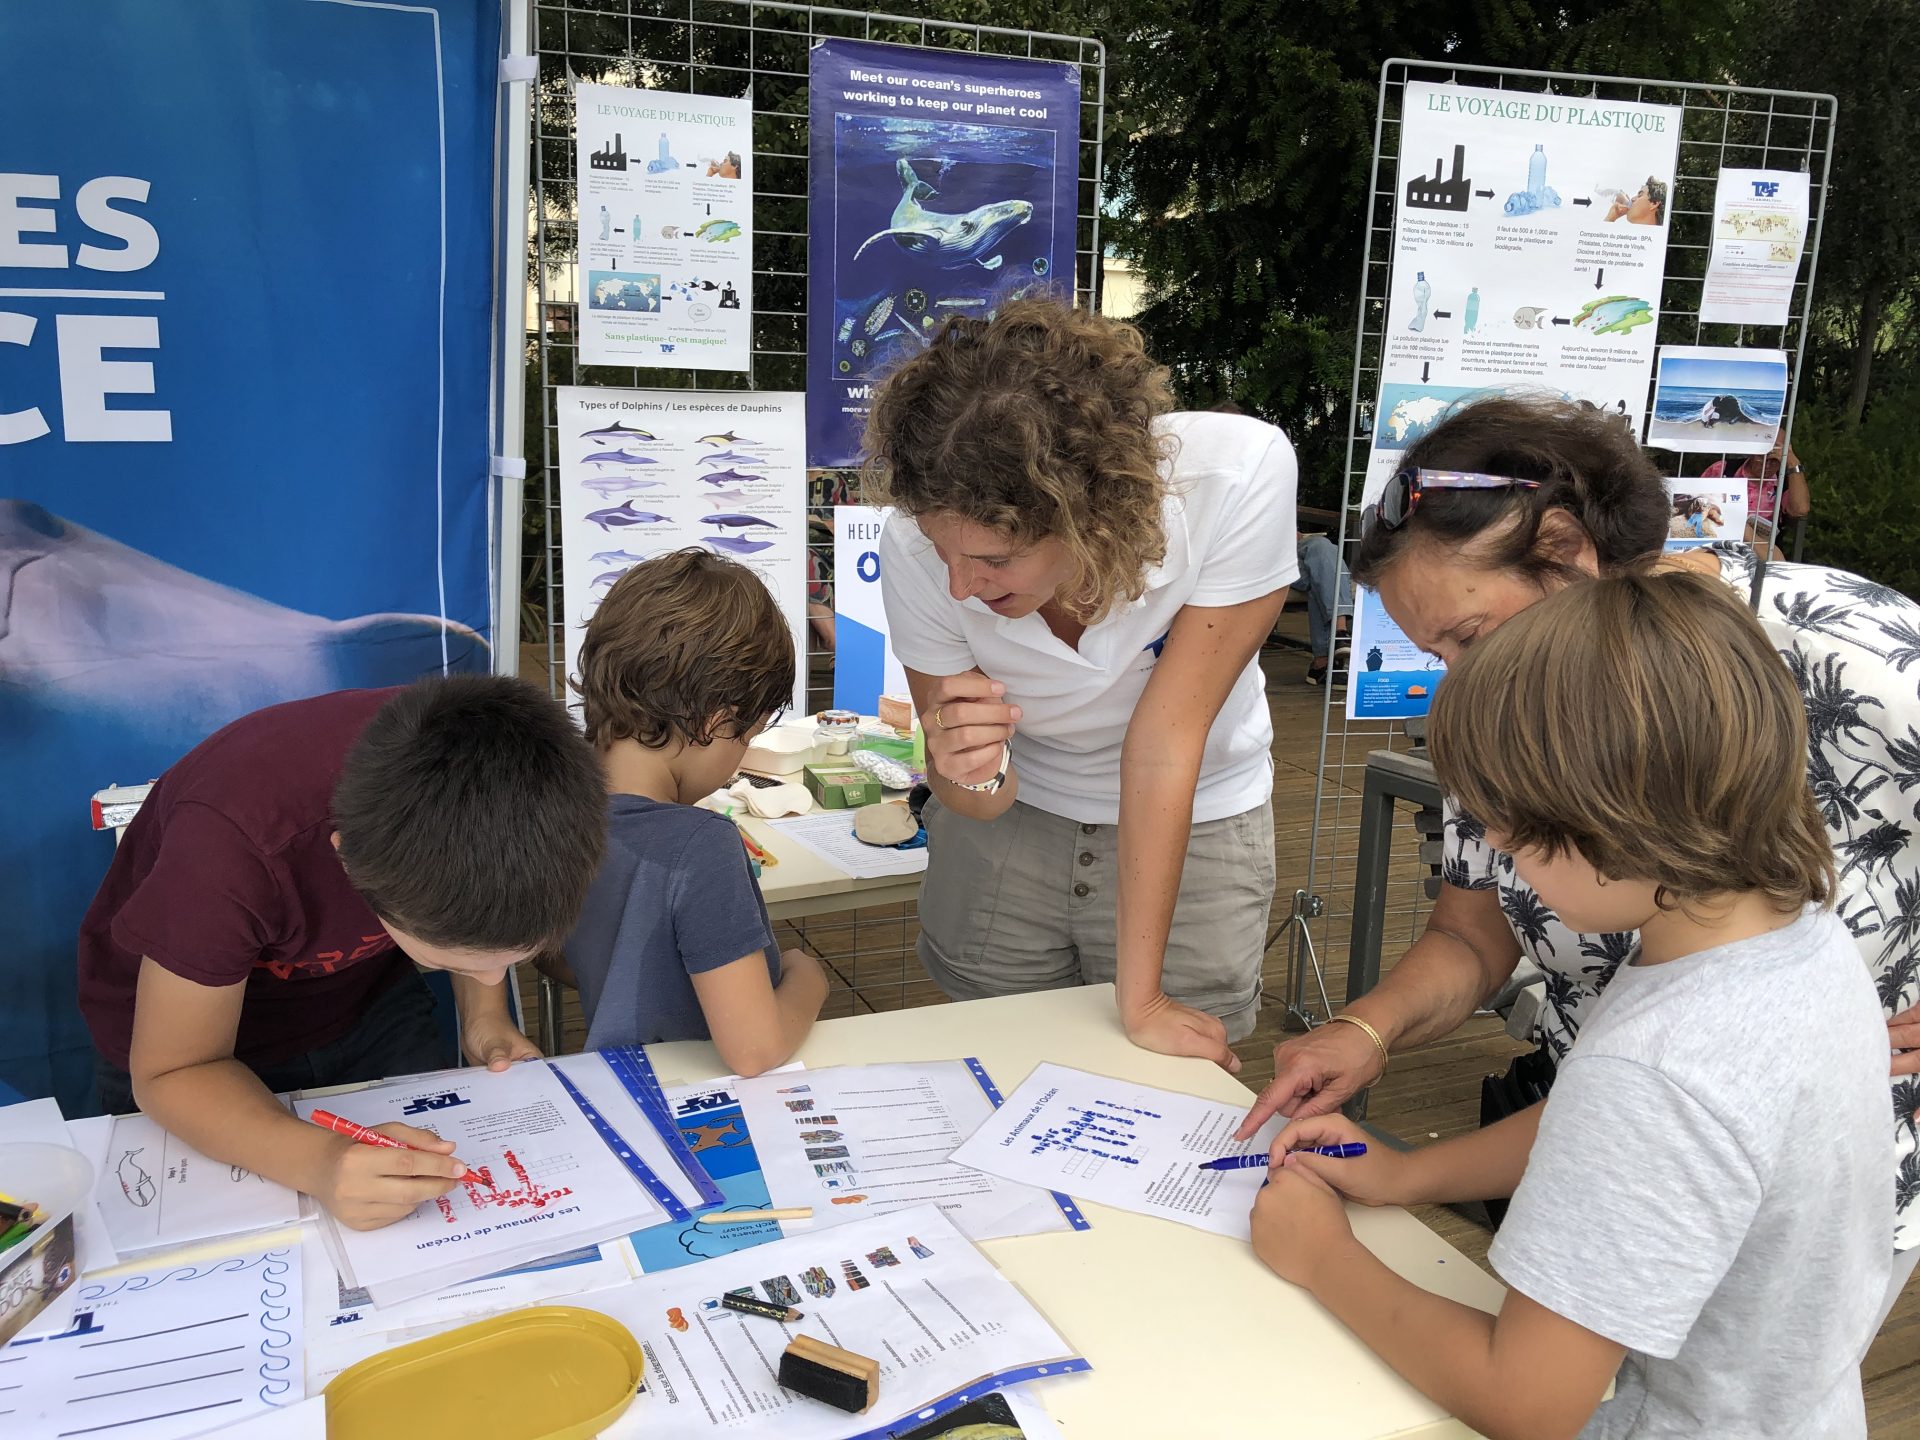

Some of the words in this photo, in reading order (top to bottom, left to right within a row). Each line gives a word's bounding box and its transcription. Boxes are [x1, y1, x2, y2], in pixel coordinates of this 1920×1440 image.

[850, 70, 883, 83] Meet
[887, 76, 908, 86] our
[912, 78, 961, 92] ocean's
[965, 83, 1041, 100] superheroes
[597, 104, 610, 115] LE
[613, 106, 656, 119] VOYAGE
[659, 110, 675, 121] DU
[677, 112, 735, 126] PLASTIQUE
[843, 90, 896, 106] working
[900, 95, 913, 106] to
[917, 96, 948, 111] keep
[952, 101, 973, 111] our
[976, 103, 1016, 117] planet
[1019, 107, 1047, 119] cool
[1428, 93, 1451, 112] LE
[1456, 96, 1530, 120] VOYAGE
[1535, 104, 1562, 123] DU
[1566, 108, 1665, 133] PLASTIQUE
[1752, 182, 1779, 197] TAF
[579, 400, 607, 411] Types
[609, 400, 620, 410] of
[622, 401, 662, 412] Dolphins
[672, 402, 687, 411] Les
[689, 402, 725, 413] espèces
[727, 404, 738, 412] de
[740, 404, 782, 414] Dauphins
[403, 1092, 471, 1116] TAF
[677, 1092, 739, 1115] TAF
[1000, 1133, 1014, 1147] Les
[1012, 1111, 1035, 1136] Animaux
[1031, 1104, 1040, 1115] de
[1036, 1086, 1059, 1108] l'Océan
[559, 1205, 581, 1216] Les
[474, 1226, 491, 1237] de
[495, 1212, 555, 1232] Animaux
[416, 1231, 471, 1251] l'Océan
[643, 1344, 661, 1373] dégradation
[661, 1380, 669, 1388] sur
[665, 1389, 677, 1404] Quizz
